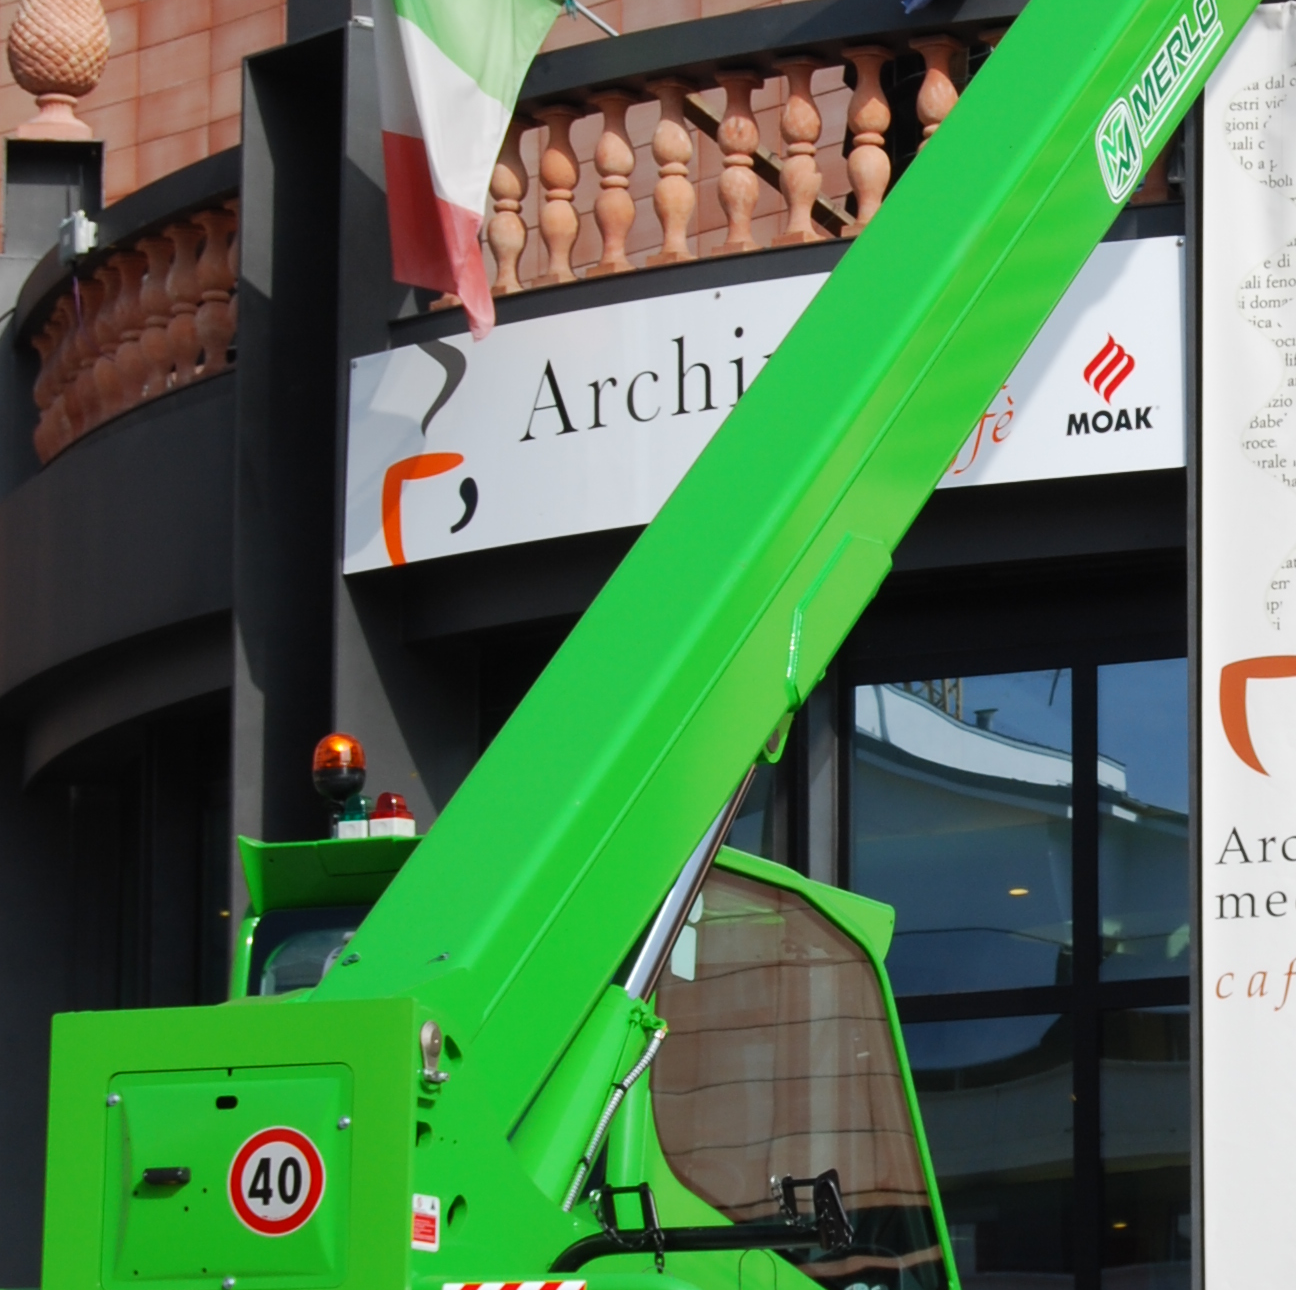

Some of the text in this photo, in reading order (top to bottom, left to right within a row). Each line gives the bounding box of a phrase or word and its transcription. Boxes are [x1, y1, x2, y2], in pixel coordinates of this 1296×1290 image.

[1265, 74, 1285, 90] dal
[1277, 253, 1291, 268] di
[519, 326, 773, 442] Archi
[1066, 406, 1153, 436] MOAK
[248, 1156, 303, 1207] 40
